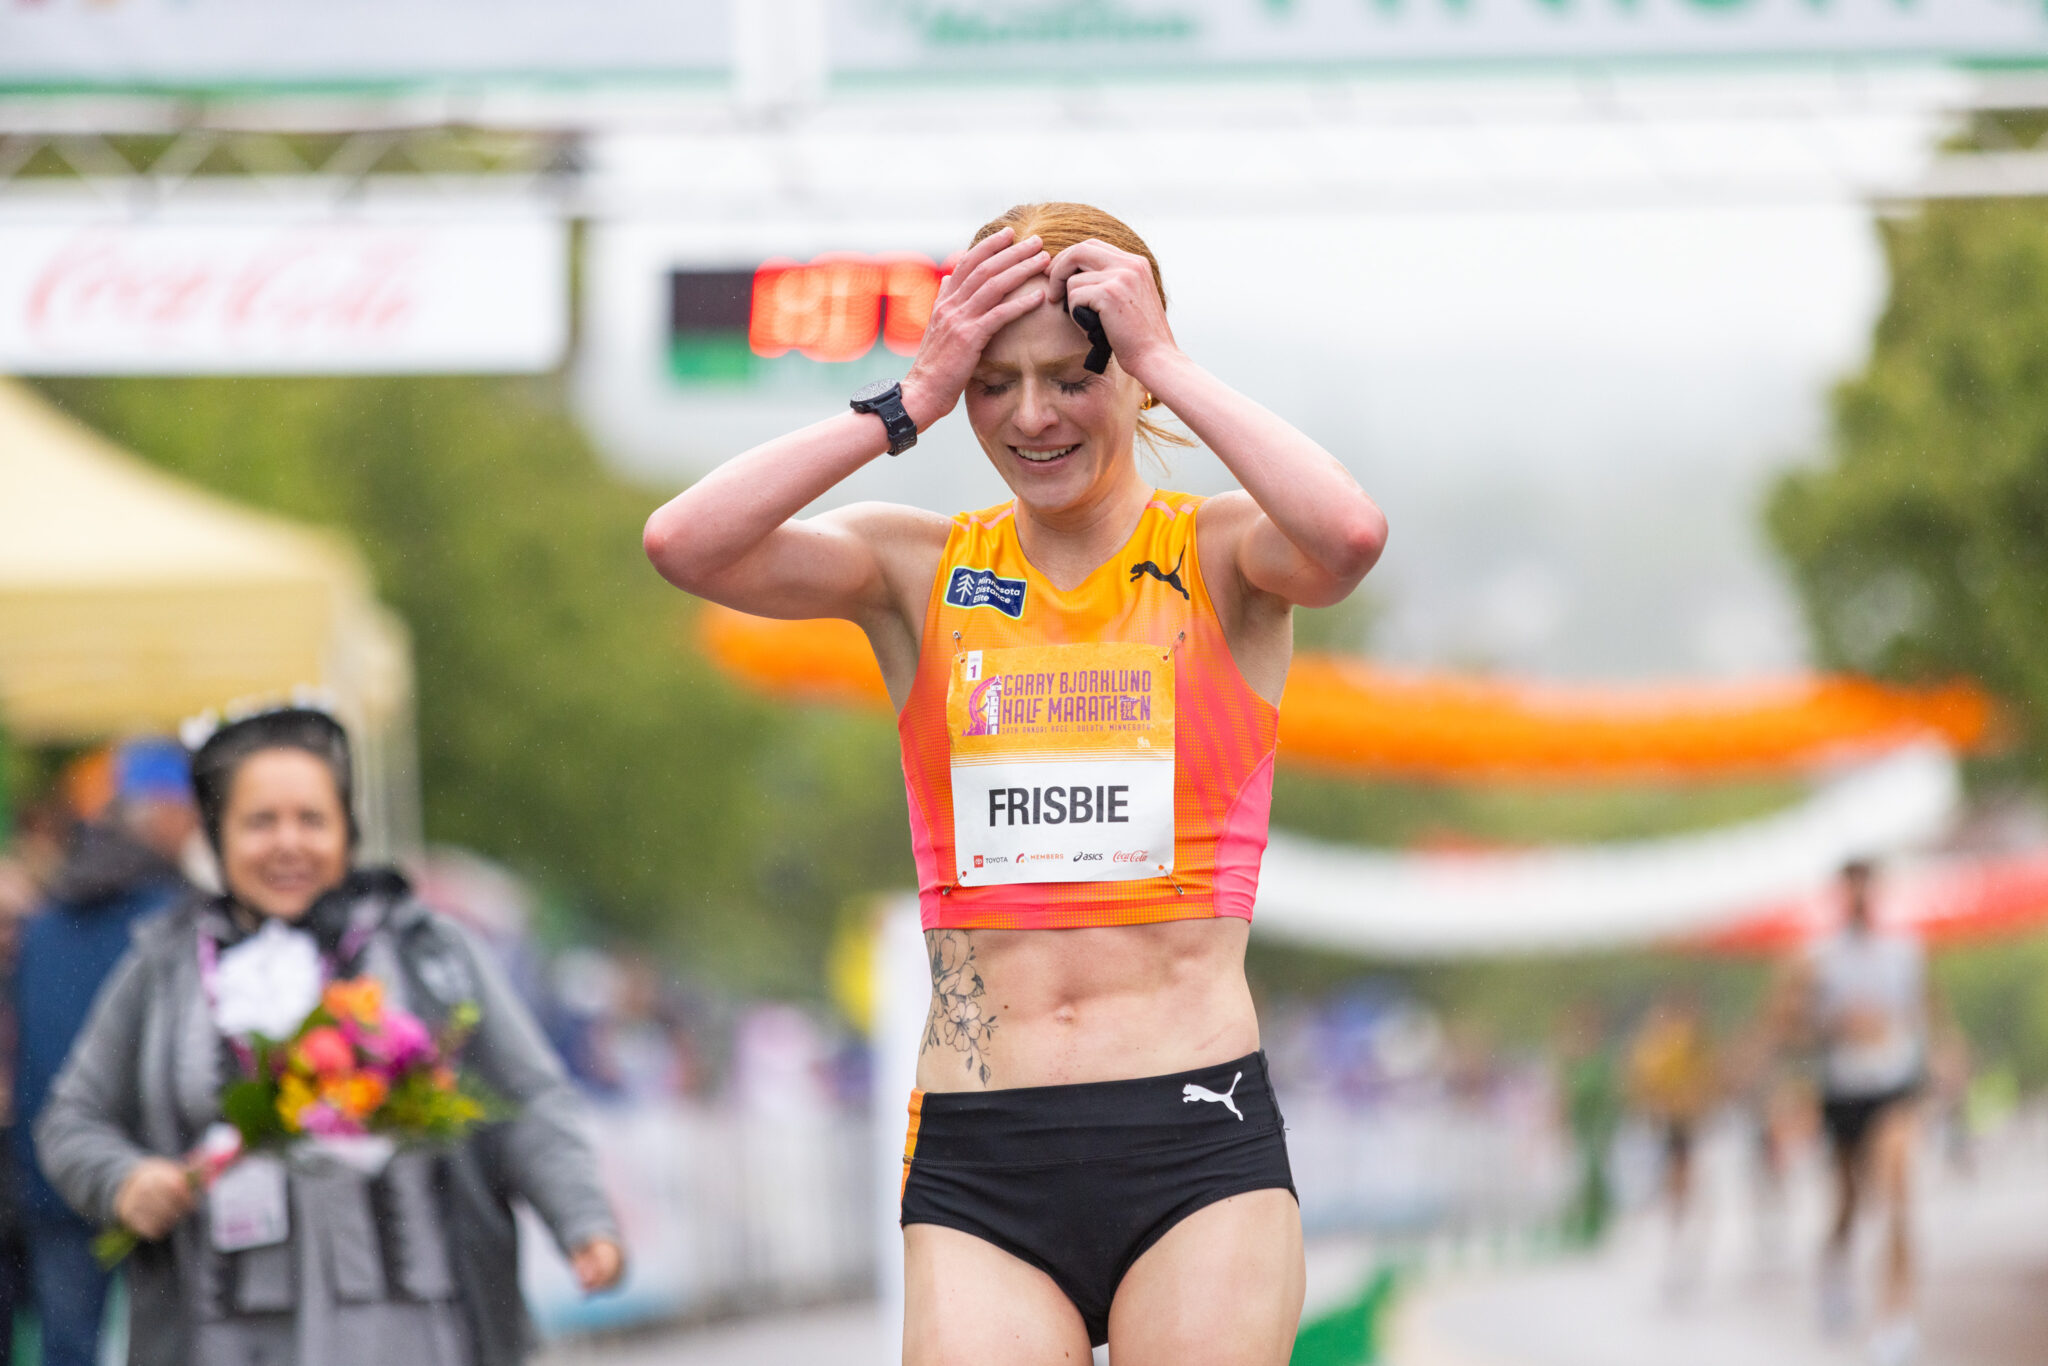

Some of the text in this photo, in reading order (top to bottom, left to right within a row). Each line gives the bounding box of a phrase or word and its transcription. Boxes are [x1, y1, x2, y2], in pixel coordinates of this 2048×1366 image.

[974, 585, 1011, 604] Distance
[977, 576, 1021, 596] Minnesota
[972, 594, 989, 603] Elite
[970, 664, 977, 679] 1
[1003, 669, 1152, 696] GARRY BJORKLUND
[1002, 694, 1151, 724] HALF MARATHN
[988, 785, 1130, 827] FRISBIE
[985, 856, 1009, 864] TOYOTA
[1030, 852, 1064, 861] MEMBERS
